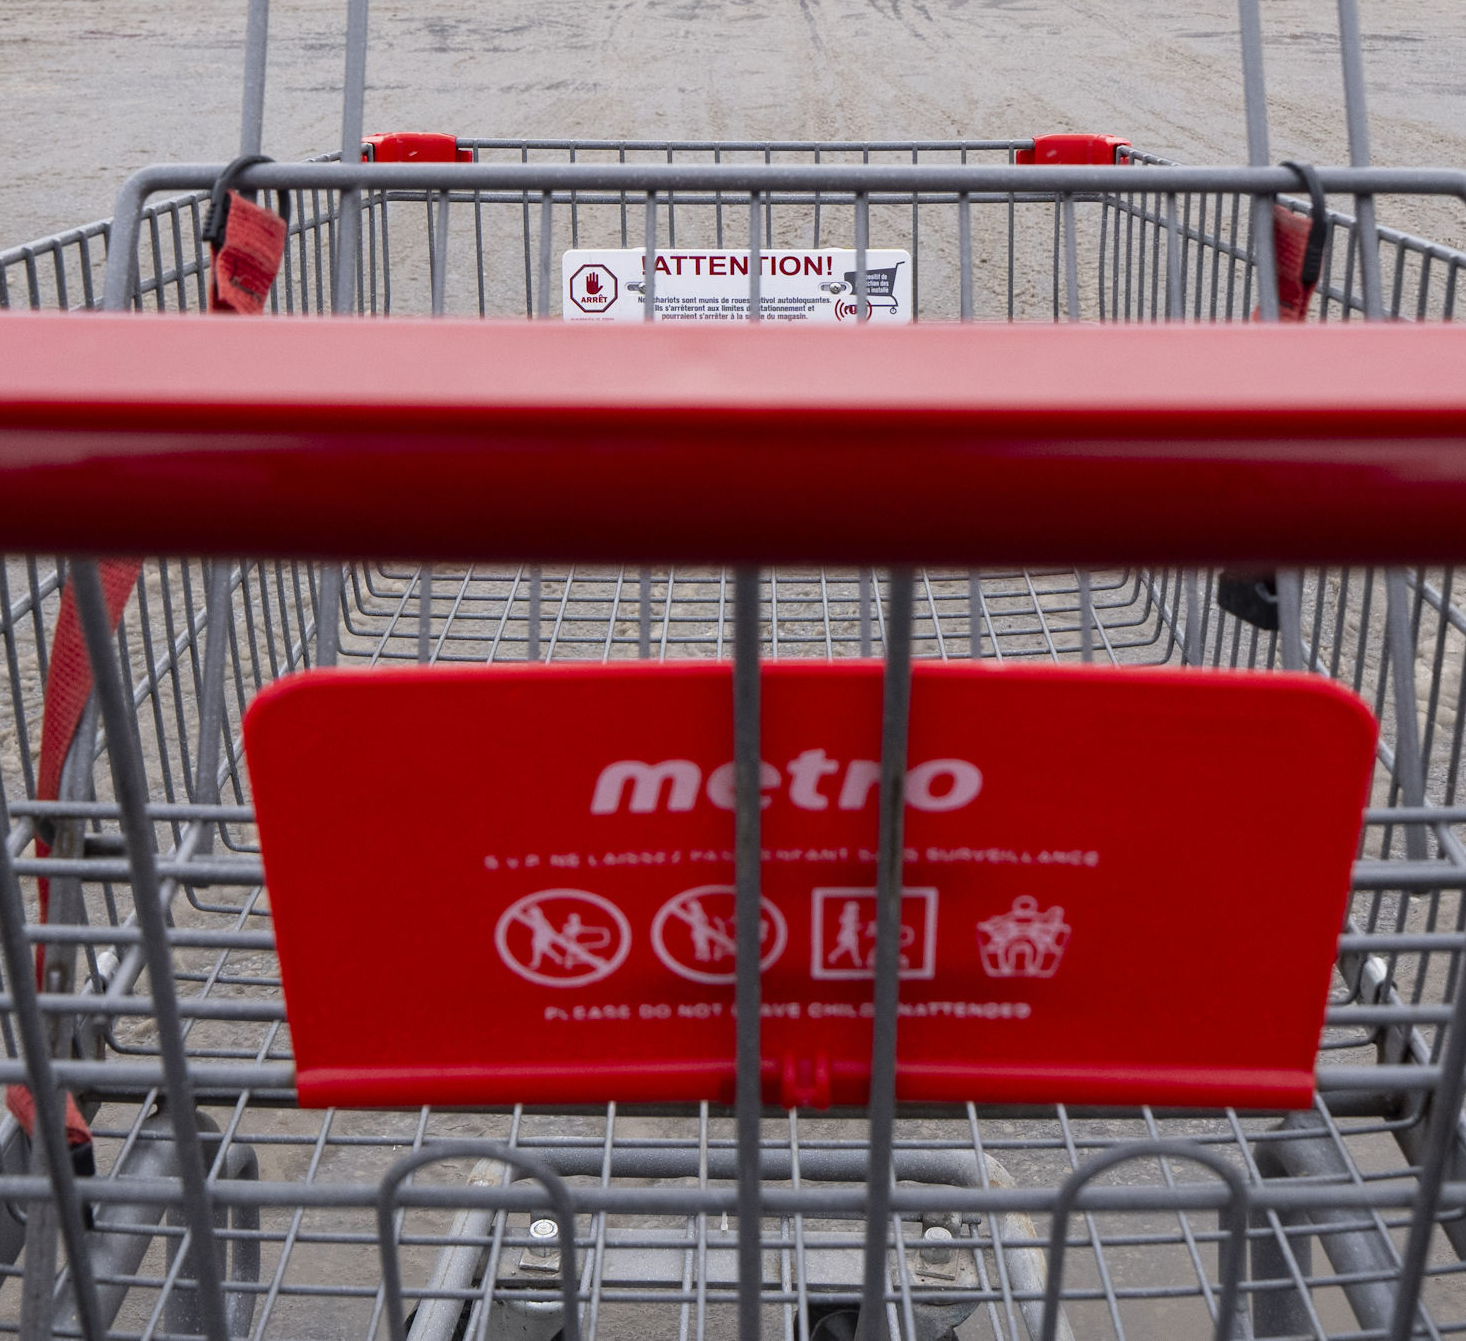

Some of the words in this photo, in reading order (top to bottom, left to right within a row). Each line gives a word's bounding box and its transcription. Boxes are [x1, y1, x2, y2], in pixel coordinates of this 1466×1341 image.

[580, 293, 608, 304] ARRÊT
[681, 296, 697, 304] sont
[699, 296, 719, 304] munis
[721, 296, 730, 304] de
[777, 296, 832, 305] autobloquantes.
[721, 304, 745, 312] limites
[759, 304, 806, 312] tationnement
[661, 313, 697, 321] pourraient
[699, 312, 728, 320] s'arrêter
[777, 312, 809, 322] magasin.
[589, 747, 984, 815] metro
[926, 847, 1100, 867] SURVEILLANCE
[544, 1003, 631, 1021] PLEASE
[638, 1003, 672, 1020] DO
[677, 1002, 723, 1020] NOT
[897, 1001, 1031, 1020] NATTENDED
